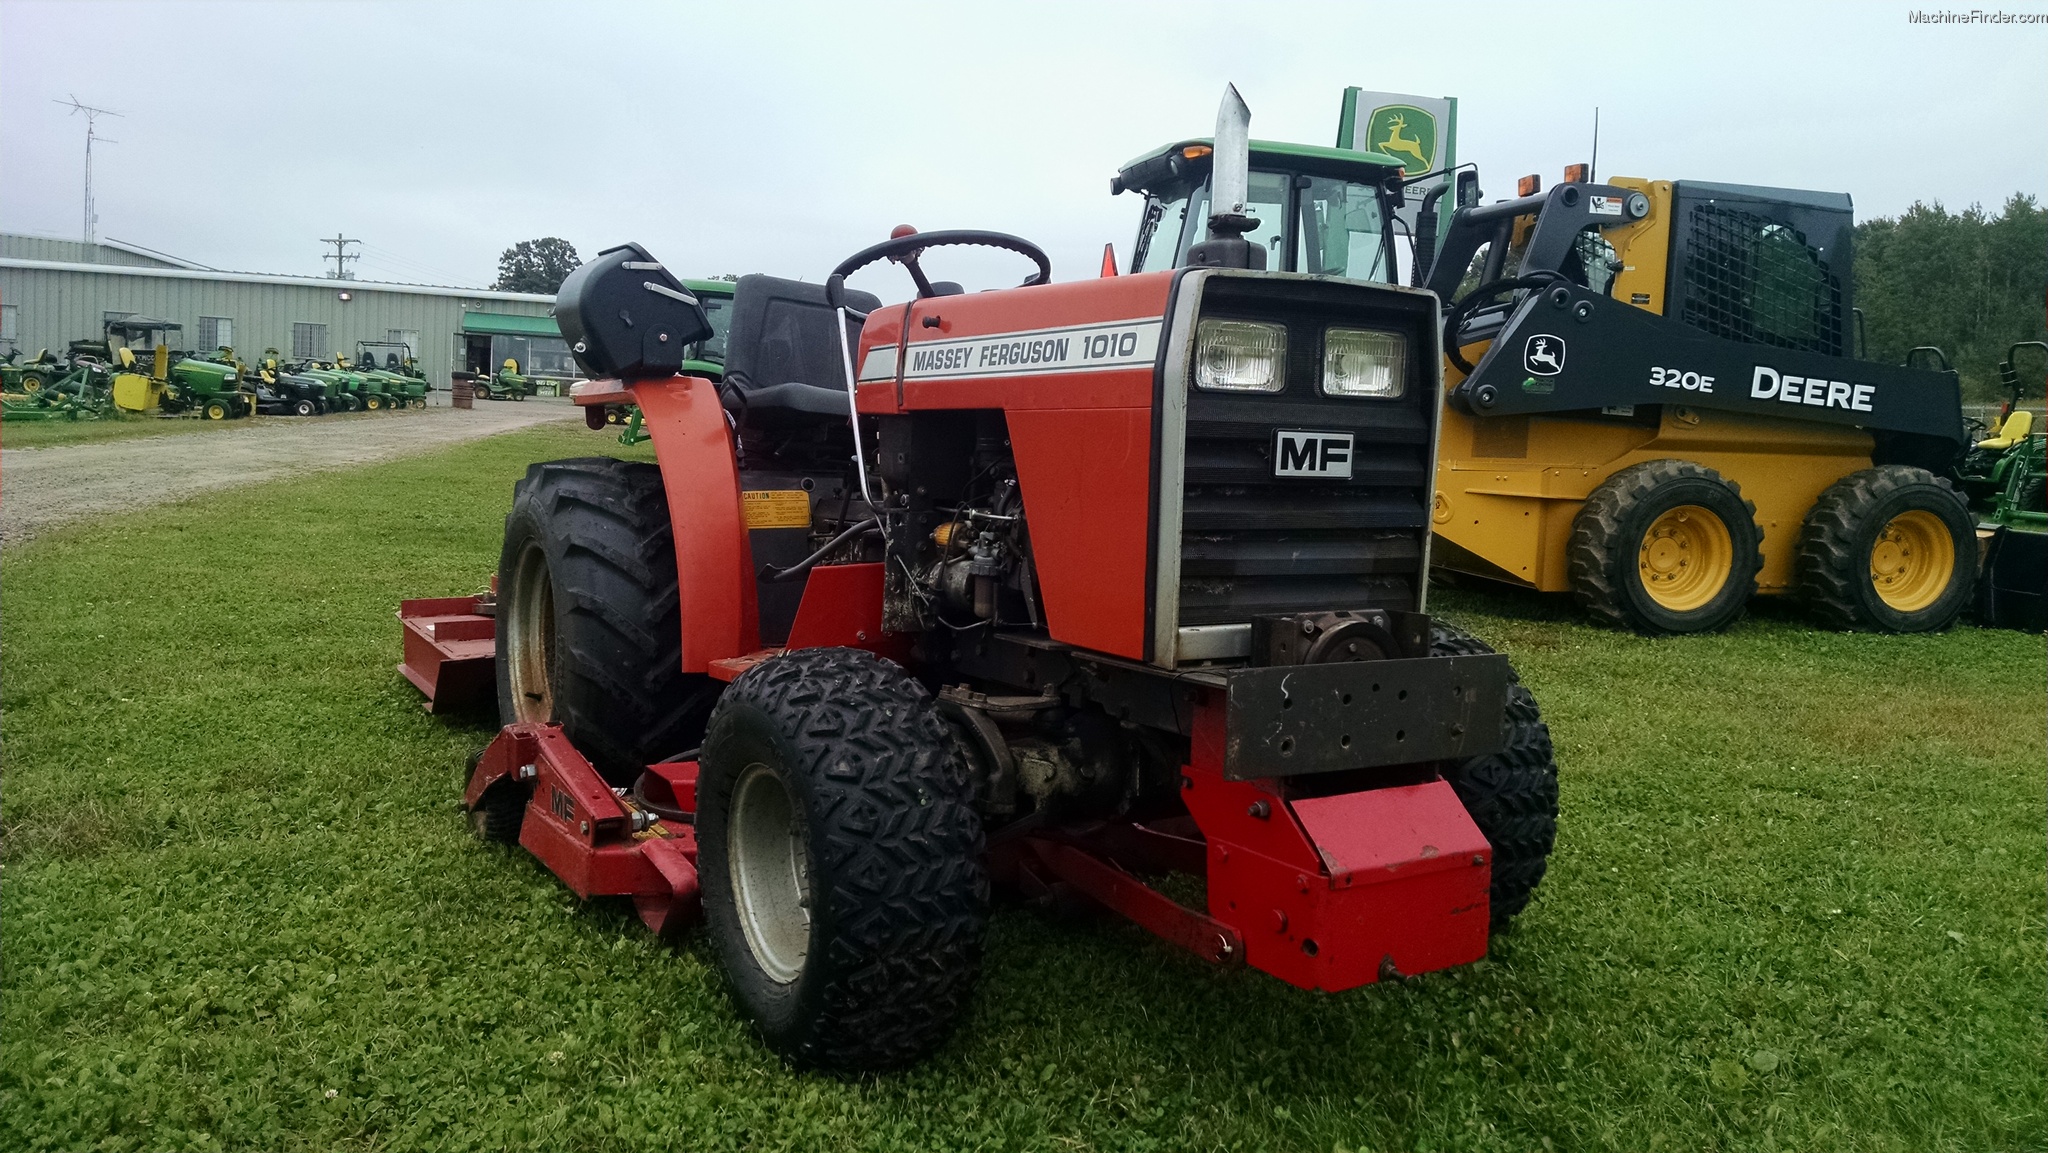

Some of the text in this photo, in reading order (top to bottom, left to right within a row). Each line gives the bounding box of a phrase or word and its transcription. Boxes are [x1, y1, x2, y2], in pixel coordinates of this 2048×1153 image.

[1405, 185, 1430, 195] EER
[912, 332, 1138, 372] MASSEY FERGUSON 1010
[1649, 366, 1715, 393] 320E
[1750, 366, 1876, 412] DEERE
[1280, 437, 1351, 471] MF
[743, 492, 770, 500] CAUTION
[551, 783, 575, 825] MF
